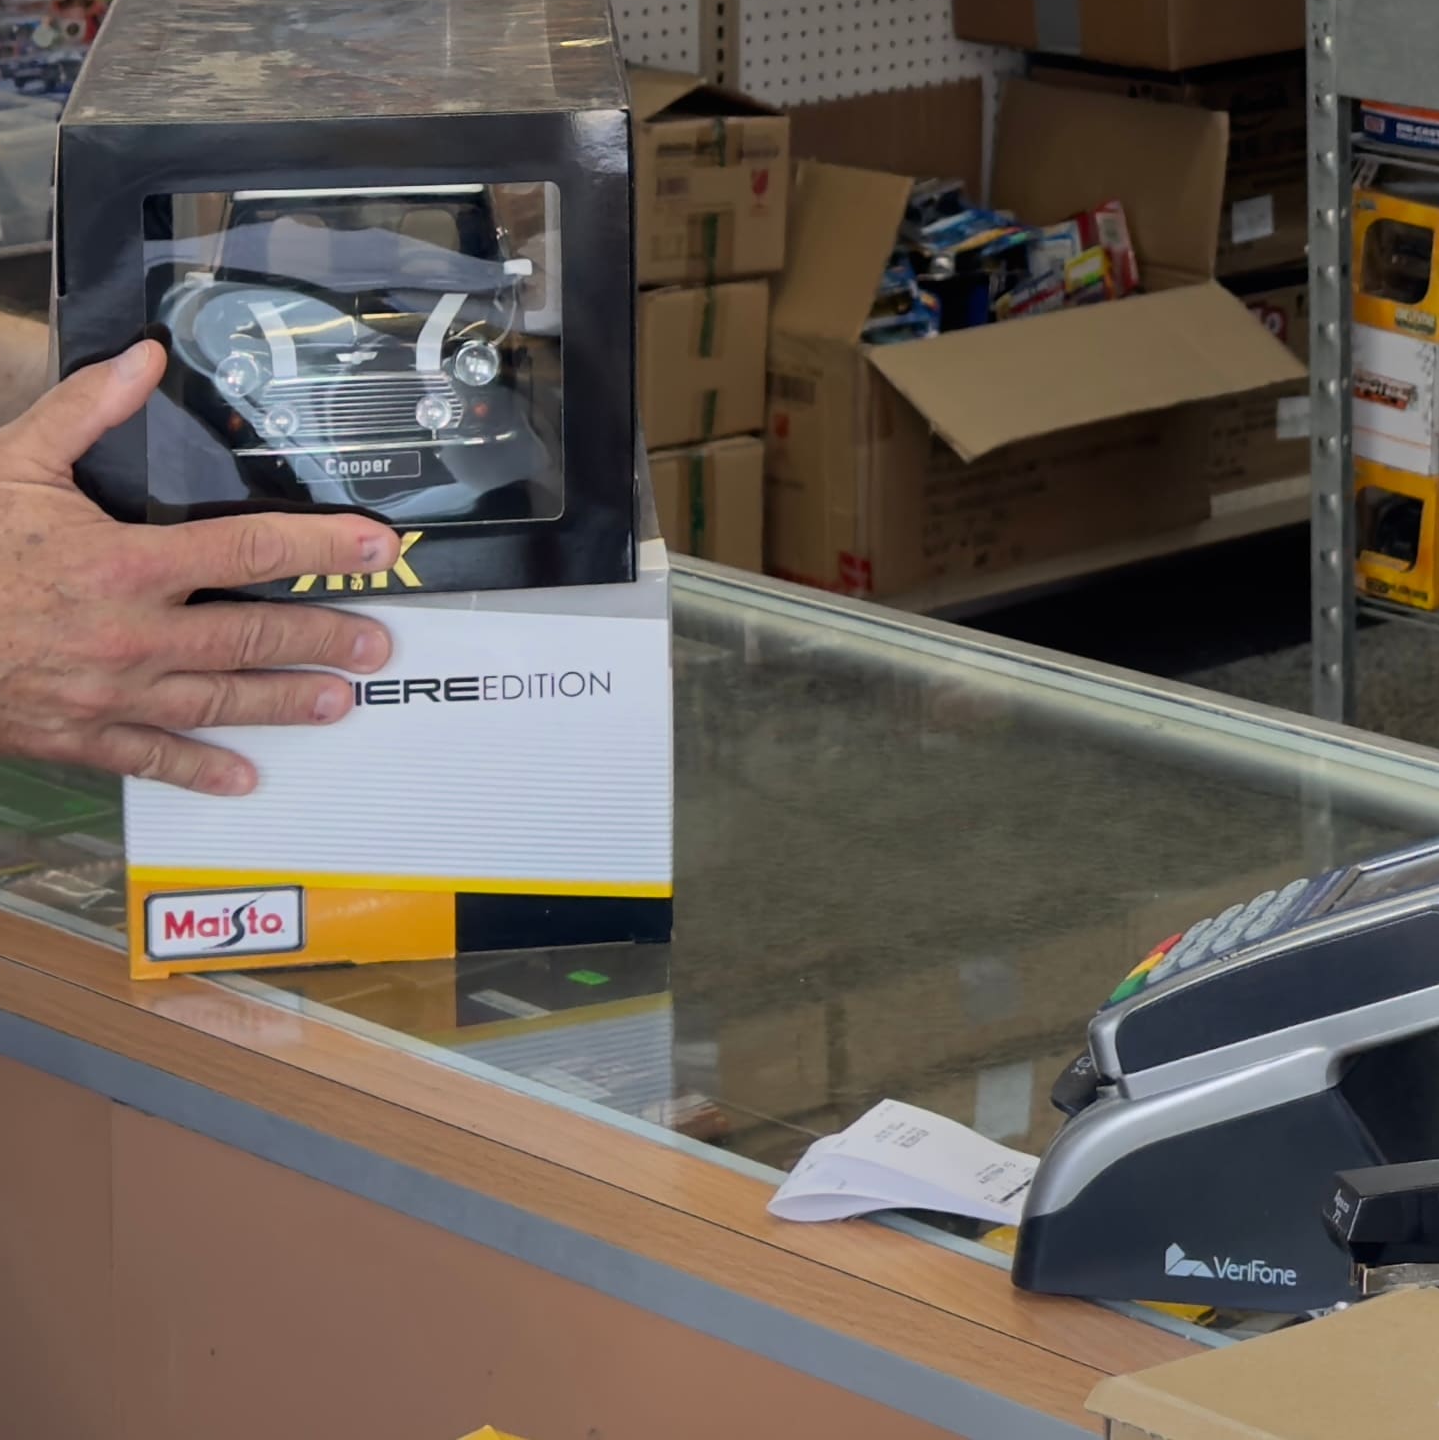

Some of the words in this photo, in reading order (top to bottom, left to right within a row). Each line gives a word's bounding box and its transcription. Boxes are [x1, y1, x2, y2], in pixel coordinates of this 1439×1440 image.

[325, 455, 392, 476] Cooper
[354, 677, 480, 707] IERE
[163, 894, 286, 951] Maisto
[1212, 1255, 1297, 1287] VeriFone
